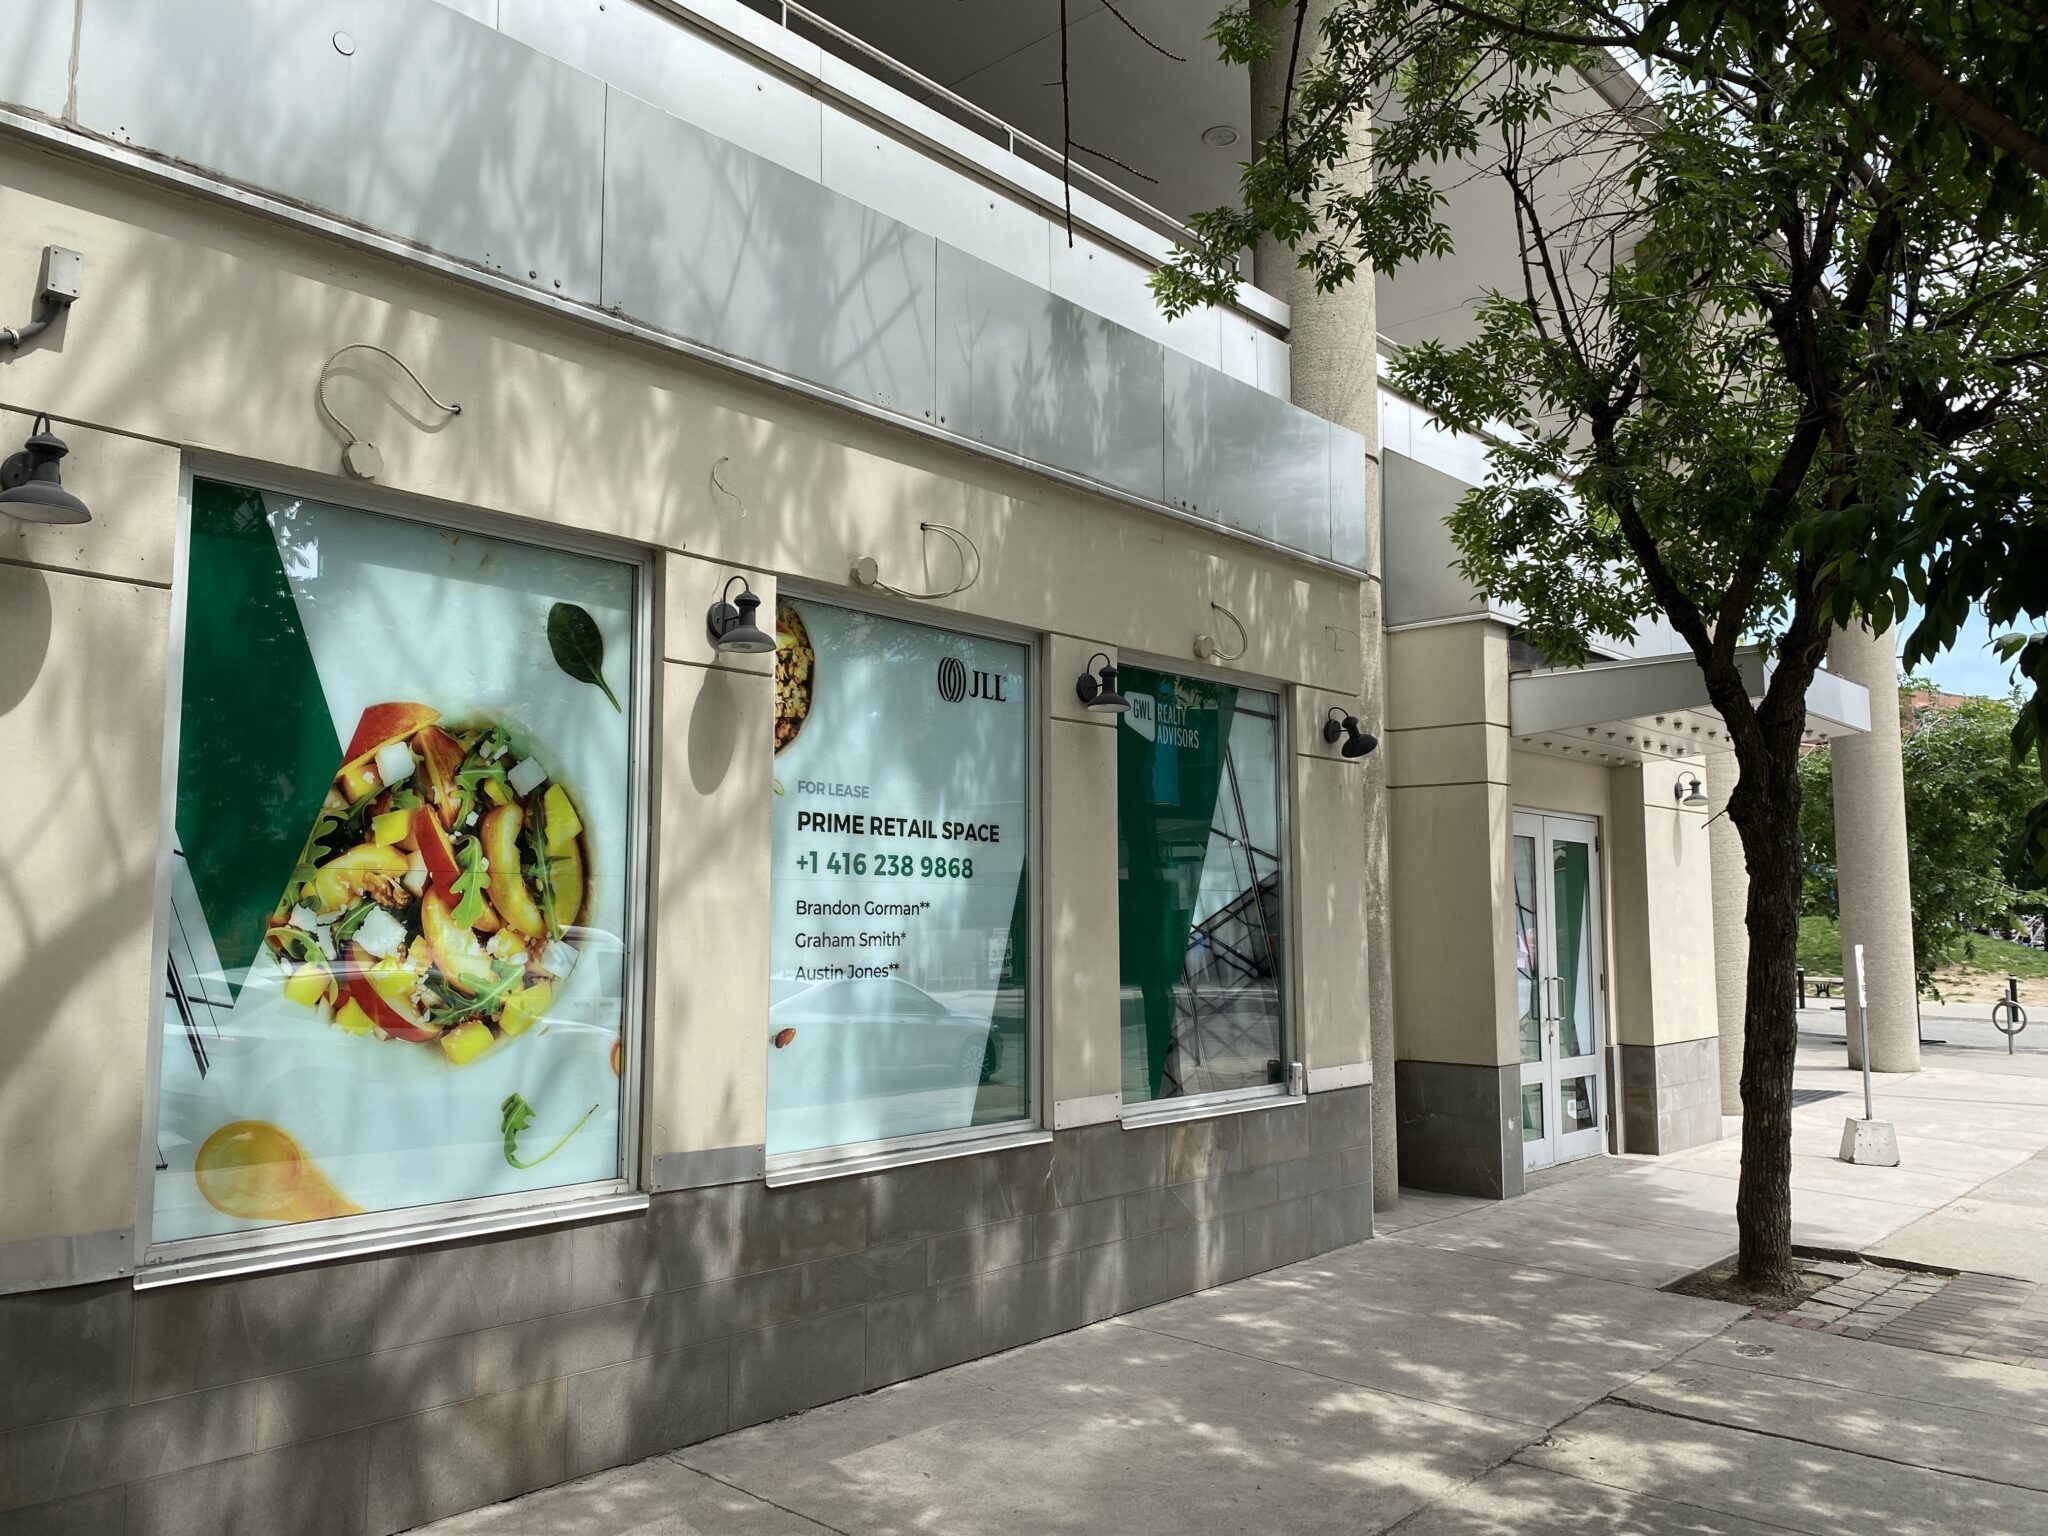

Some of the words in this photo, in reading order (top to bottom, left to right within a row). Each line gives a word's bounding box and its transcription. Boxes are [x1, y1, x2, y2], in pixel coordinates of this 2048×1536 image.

[968, 670, 1007, 702] JLL
[1133, 699, 1152, 721] GWL
[1157, 703, 1187, 726] REALTY
[1157, 725, 1200, 749] ADVISORS
[797, 781, 826, 795] FOR
[828, 783, 869, 799] LEASE
[797, 811, 864, 835] PRIME
[870, 816, 937, 839] RETAIL
[941, 821, 1000, 843] SPACE
[796, 851, 818, 874] +1
[826, 852, 867, 876] 416
[873, 854, 914, 877] 238
[920, 856, 974, 879] 9868
[796, 900, 860, 916] Brandon
[795, 932, 855, 948] Graham
[795, 964, 844, 981] Austin
